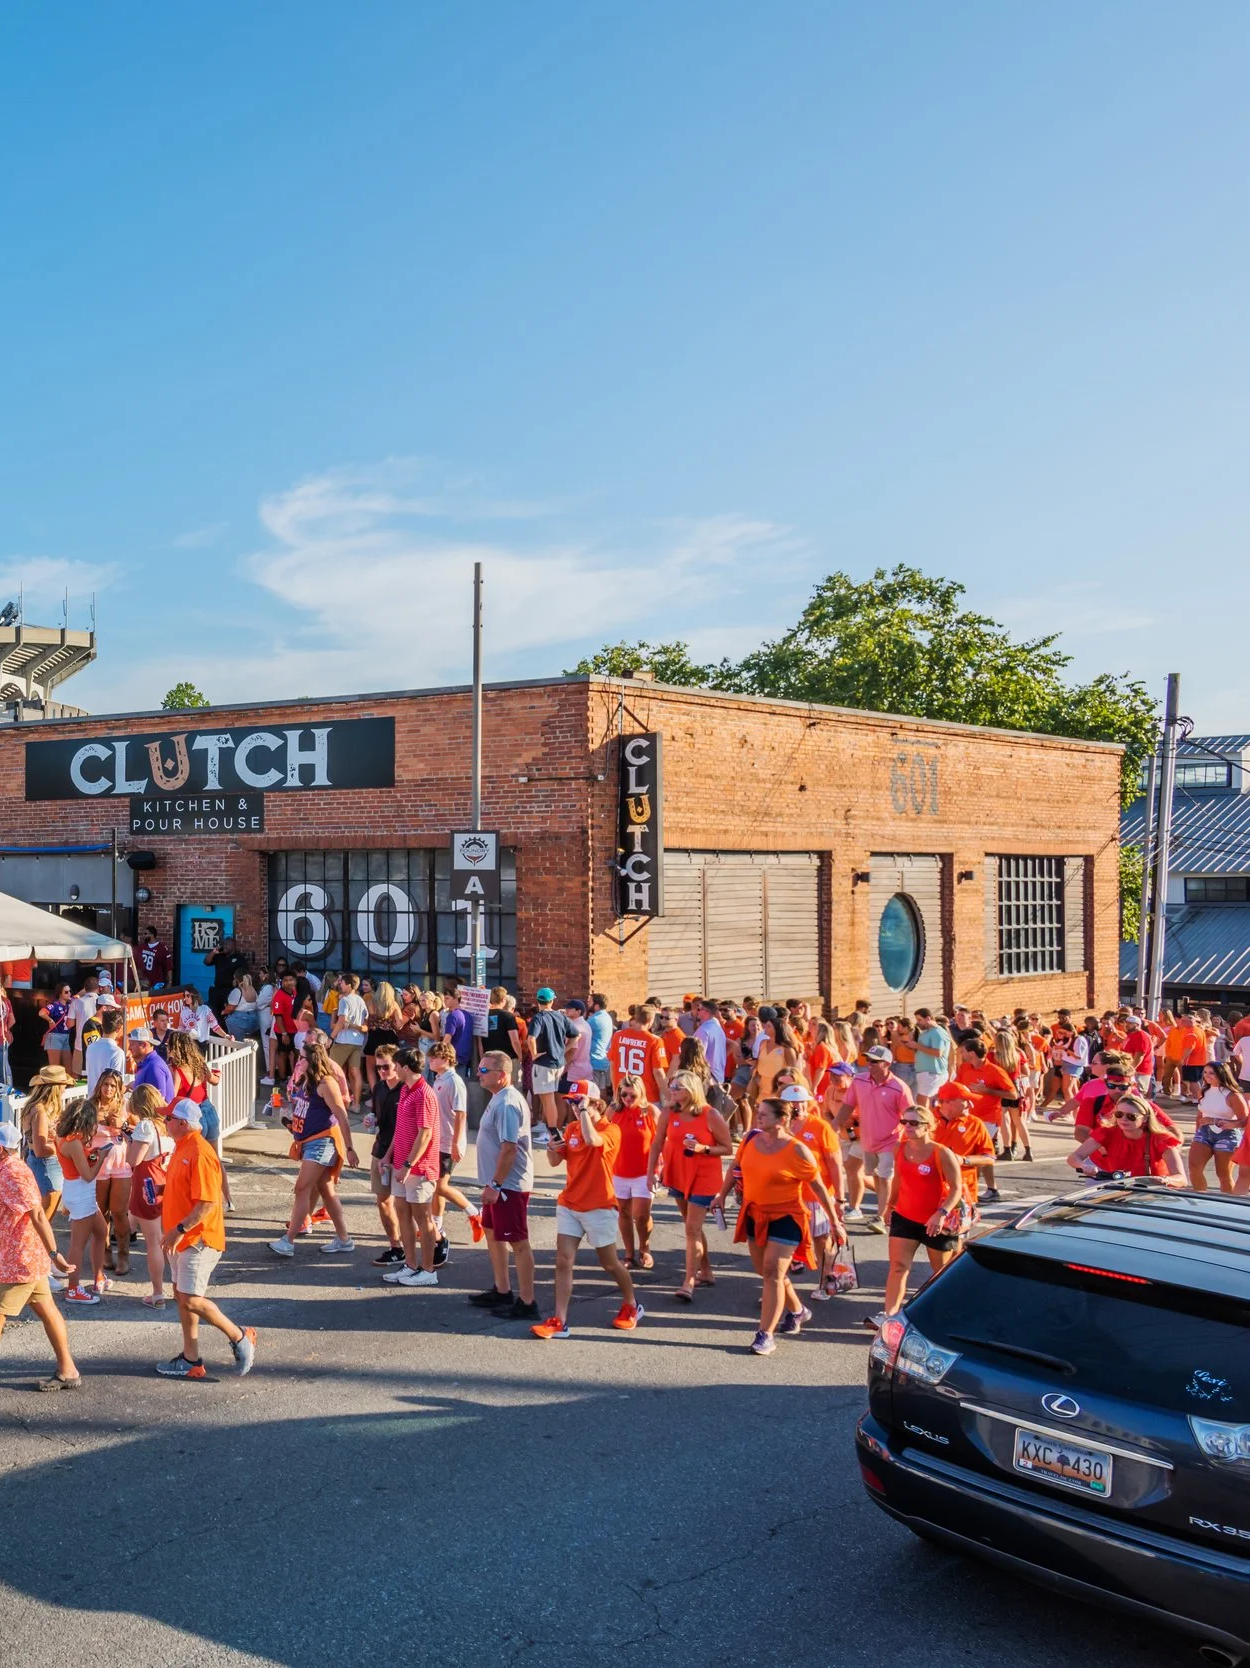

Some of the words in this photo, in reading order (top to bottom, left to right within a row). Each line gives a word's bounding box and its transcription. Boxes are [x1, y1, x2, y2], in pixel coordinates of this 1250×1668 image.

[70, 728, 334, 795] CLUTCH
[143, 799, 225, 814] KITCHEN
[238, 798, 248, 810] &
[133, 819, 183, 831] POUR
[194, 817, 260, 830] HOUSE
[624, 738, 652, 911] CLUTCH
[463, 875, 485, 895] A
[618, 1035, 648, 1049] LAWRENCE
[618, 1045, 645, 1076] 16
[903, 1420, 950, 1445] LEXUS
[1021, 1439, 1053, 1466] KXC
[1071, 1456, 1103, 1481] 430
